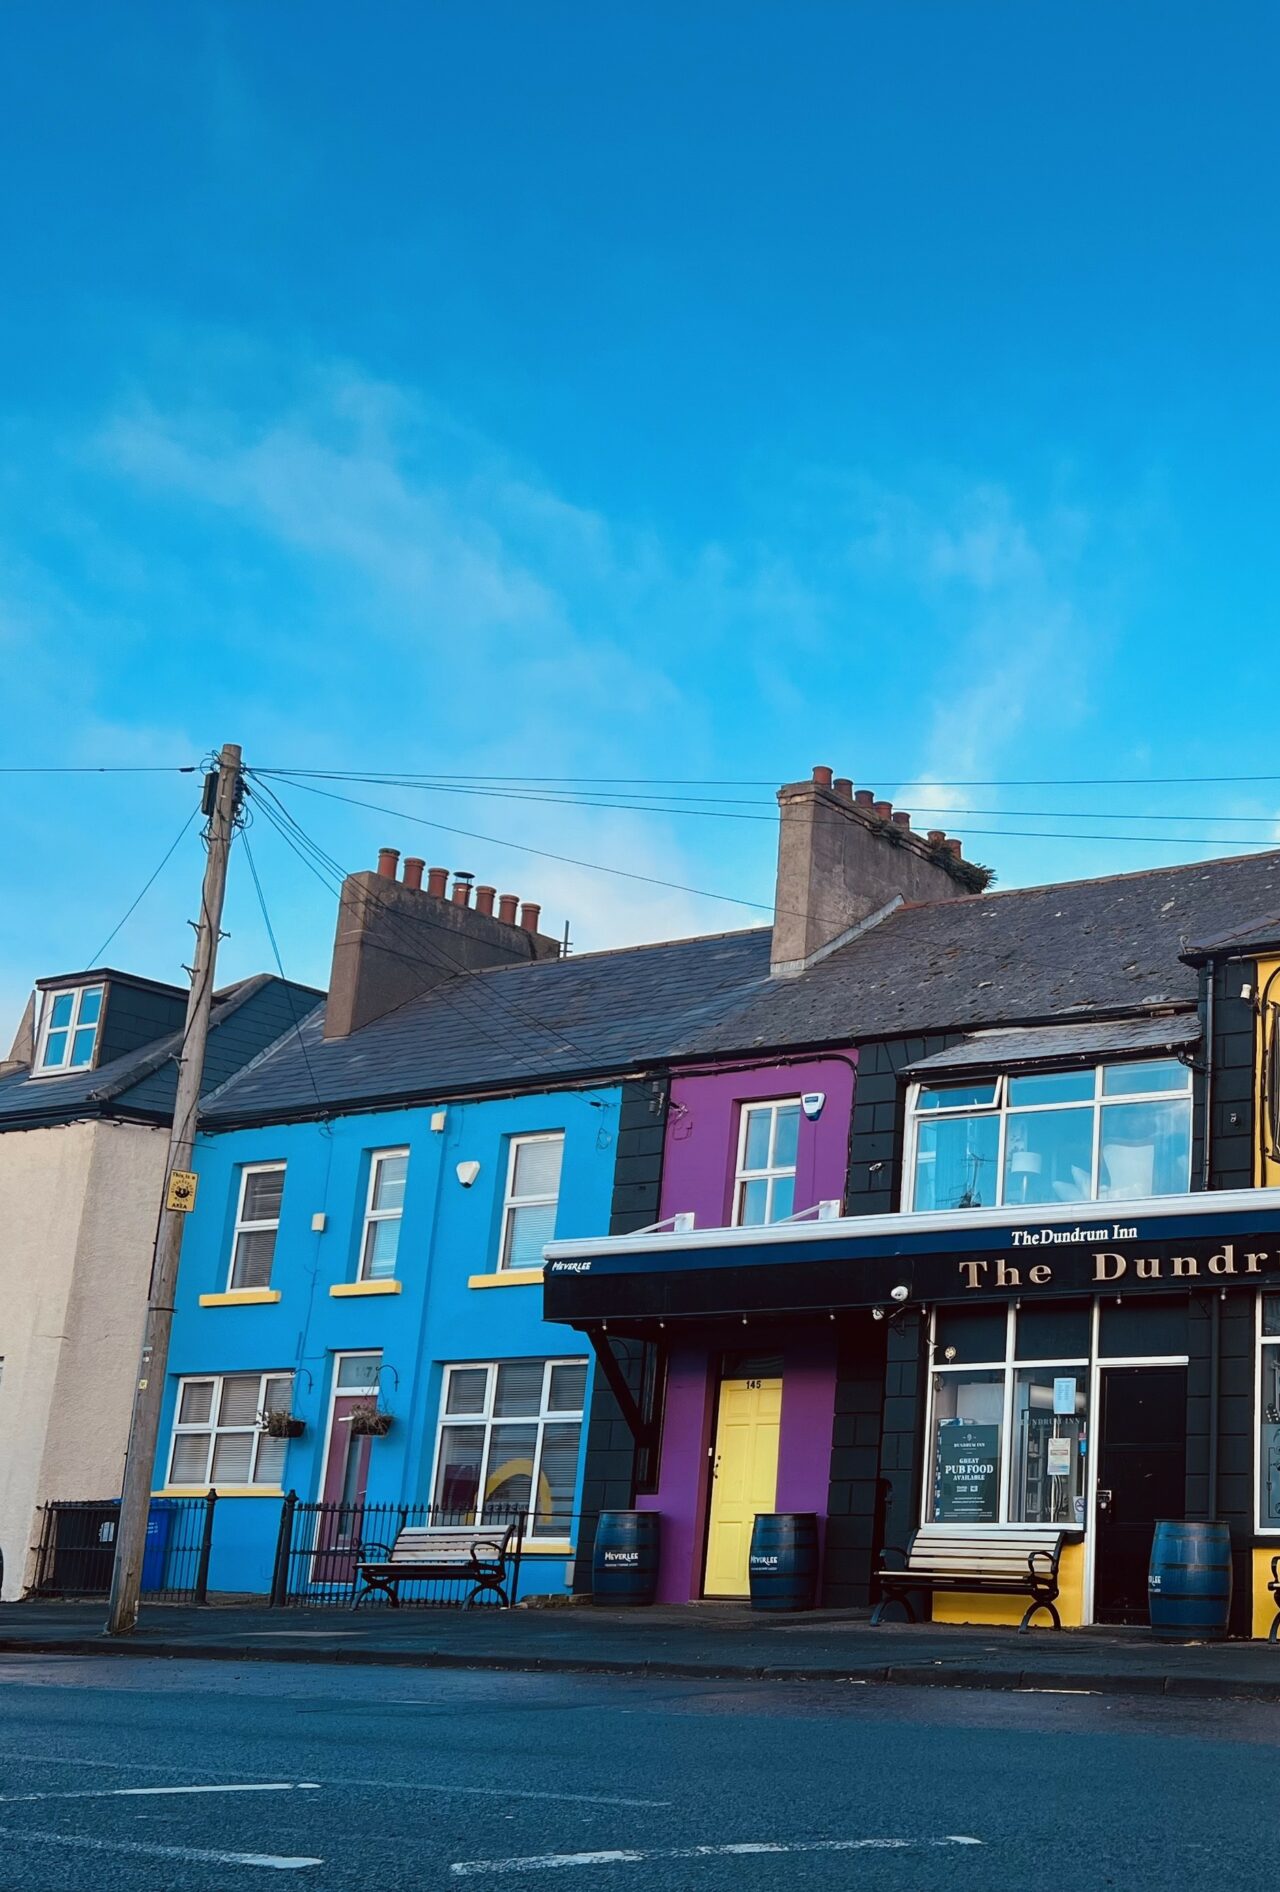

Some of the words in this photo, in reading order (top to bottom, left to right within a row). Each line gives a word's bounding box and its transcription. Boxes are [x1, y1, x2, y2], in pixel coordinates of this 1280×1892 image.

[1011, 1230, 1039, 1246] The
[1039, 1226, 1109, 1244] Dundrum
[1111, 1224, 1138, 1240] Inn
[958, 1259, 1053, 1290] The
[746, 1380, 762, 1390] 145
[945, 1465, 966, 1474] PUB
[967, 1464, 994, 1474] FOOD
